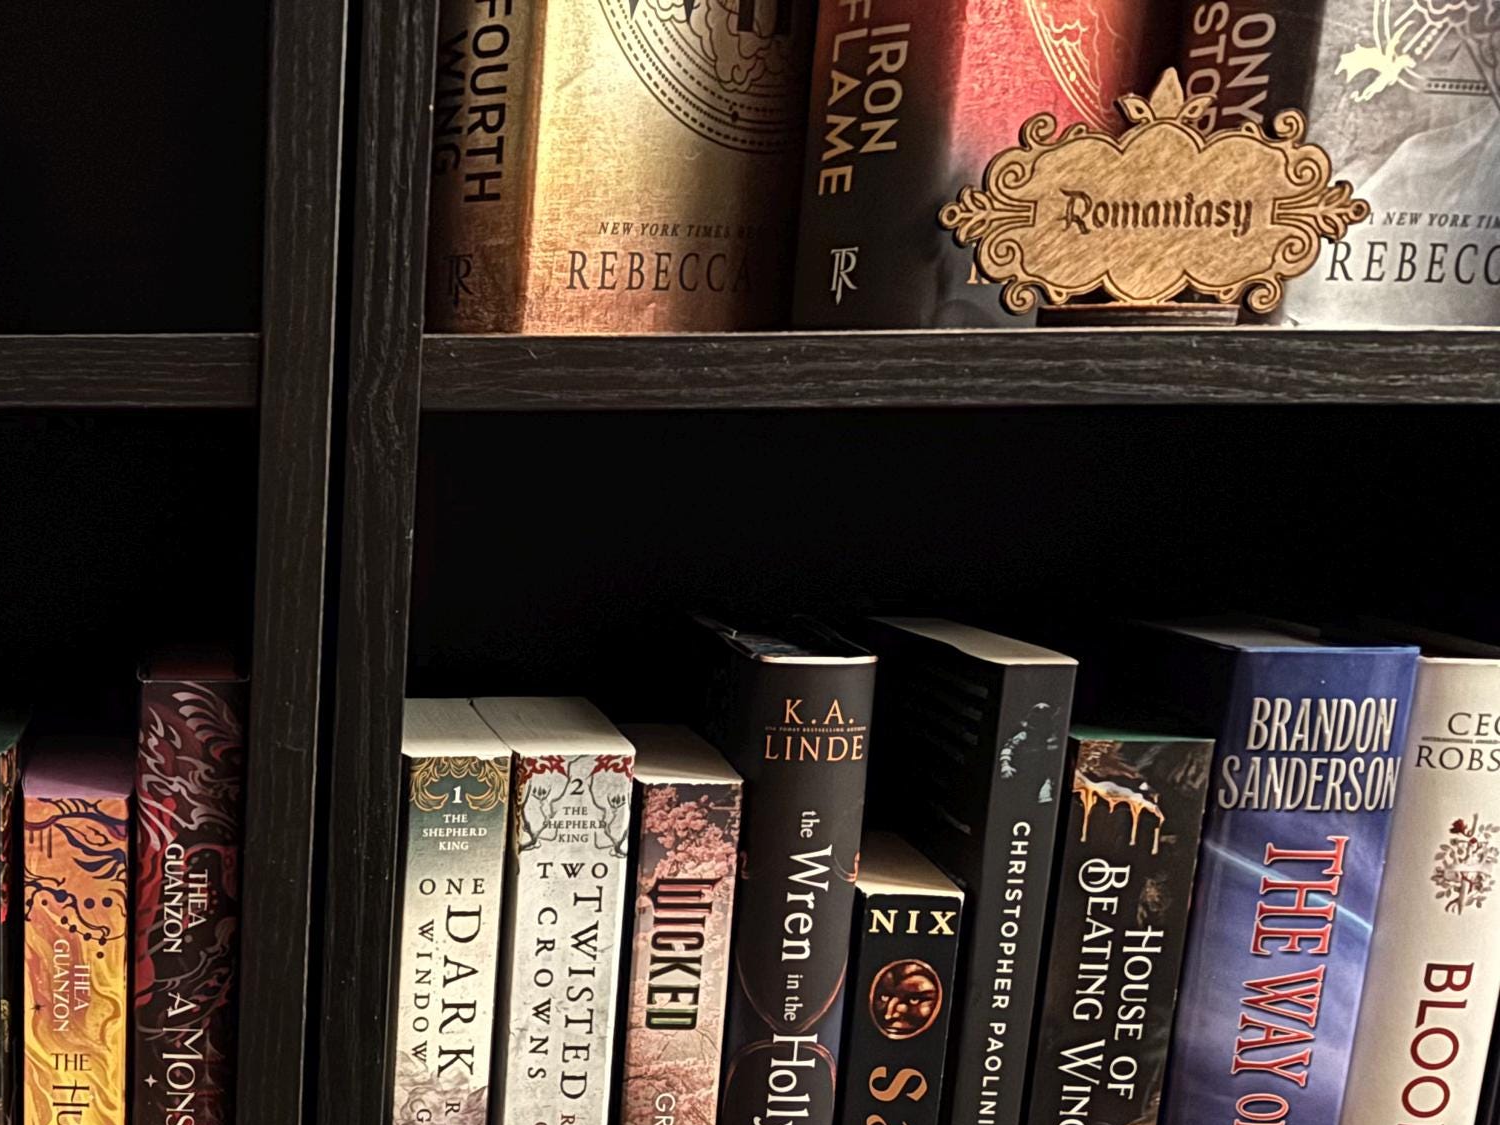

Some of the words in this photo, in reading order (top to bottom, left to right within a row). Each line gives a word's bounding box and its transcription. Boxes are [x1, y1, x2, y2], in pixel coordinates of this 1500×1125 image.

[858, 23, 911, 154] IRON
[1059, 187, 1253, 238] Romantasy
[1382, 211, 1421, 227] NEW
[1427, 212, 1471, 228] YORK
[566, 250, 758, 293] REBECCA
[764, 734, 864, 762] LINDE
[1246, 696, 1398, 753] BRANDON
[451, 785, 463, 804] 1
[1217, 755, 1402, 812] SANDERSON
[422, 826, 488, 838] SHEPHERD
[442, 813, 469, 824] THE
[542, 819, 607, 830] SHEPHERD
[562, 805, 588, 816] THE
[799, 810, 821, 839] the
[438, 840, 470, 851] KING
[557, 832, 589, 844] KING
[418, 877, 486, 895] ONE
[536, 861, 610, 880] TWO
[161, 843, 186, 954] GUANZON
[781, 844, 833, 962] Wren
[989, 821, 1032, 1010] CHRISTOPHER
[1249, 834, 1350, 956] THE
[868, 908, 957, 935] NIX
[1073, 857, 1131, 1022] BEATING
[645, 876, 722, 1032] WICKED
[51, 938, 70, 1033] GUANZON
[411, 918, 435, 1063] WINDOW
[437, 904, 483, 1078] DARK
[527, 905, 559, 1081] CROWNS
[559, 886, 604, 1100] TWISTED
[787, 973, 804, 990] in
[783, 991, 804, 1022] the
[1231, 963, 1327, 1088] WAY
[51, 1053, 92, 1072] THE
[978, 1022, 1006, 1125] PAOLINI
